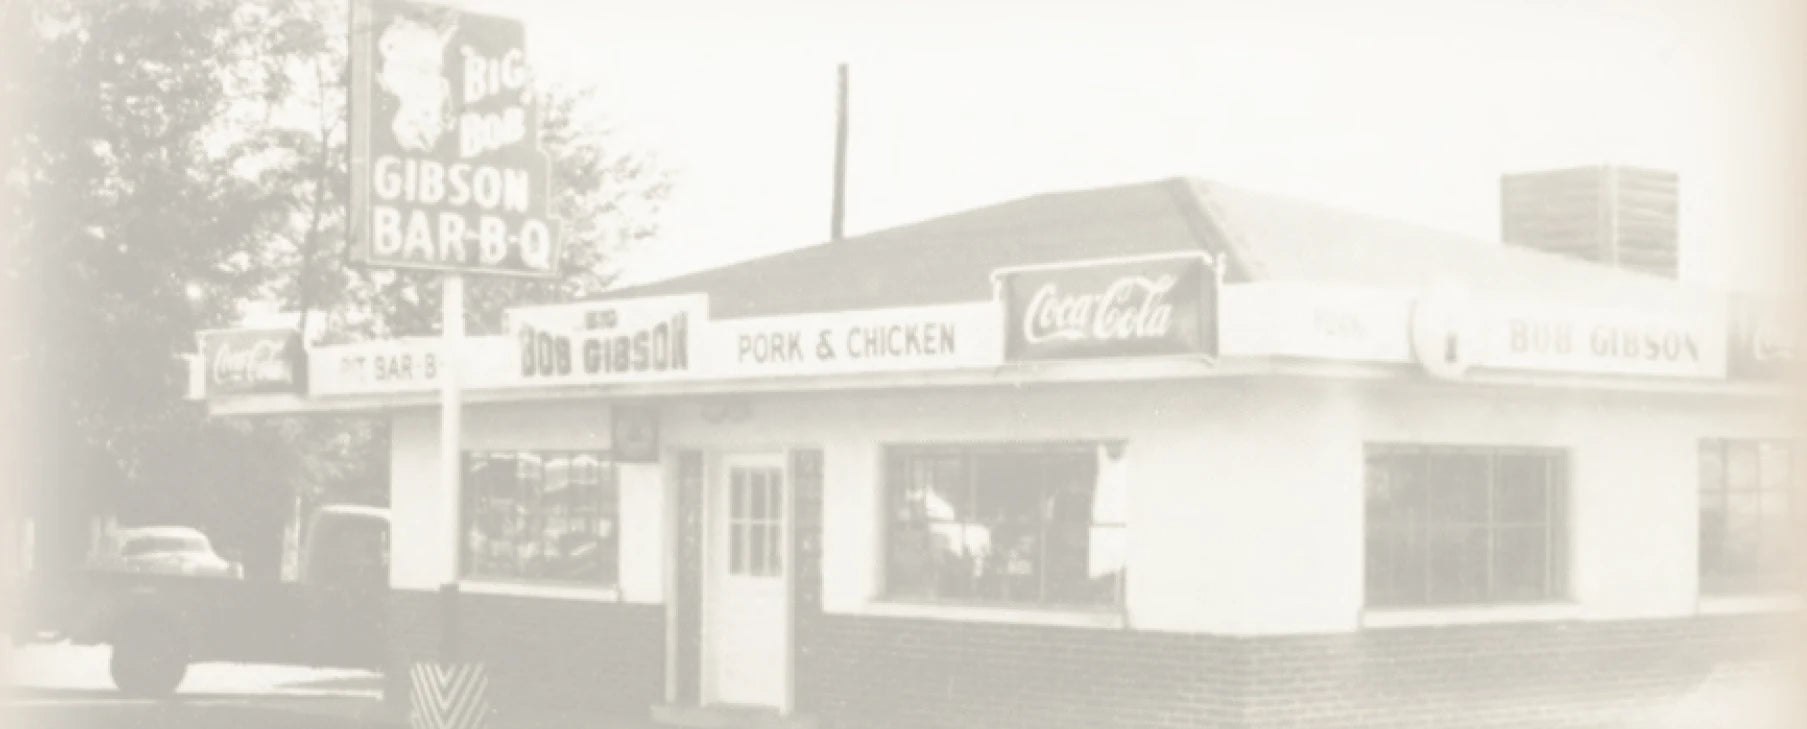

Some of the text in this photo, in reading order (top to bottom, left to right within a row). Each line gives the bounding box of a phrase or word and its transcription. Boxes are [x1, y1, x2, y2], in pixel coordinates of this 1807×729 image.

[374, 154, 530, 214] GIBSON
[373, 205, 550, 270] BAR-B-Q
[1023, 272, 1178, 344] Coca-Cola
[519, 311, 689, 377] BOB GIBSON
[738, 322, 957, 364] PORK & CHICKEN
[1508, 317, 1700, 363] BOB GIBSON
